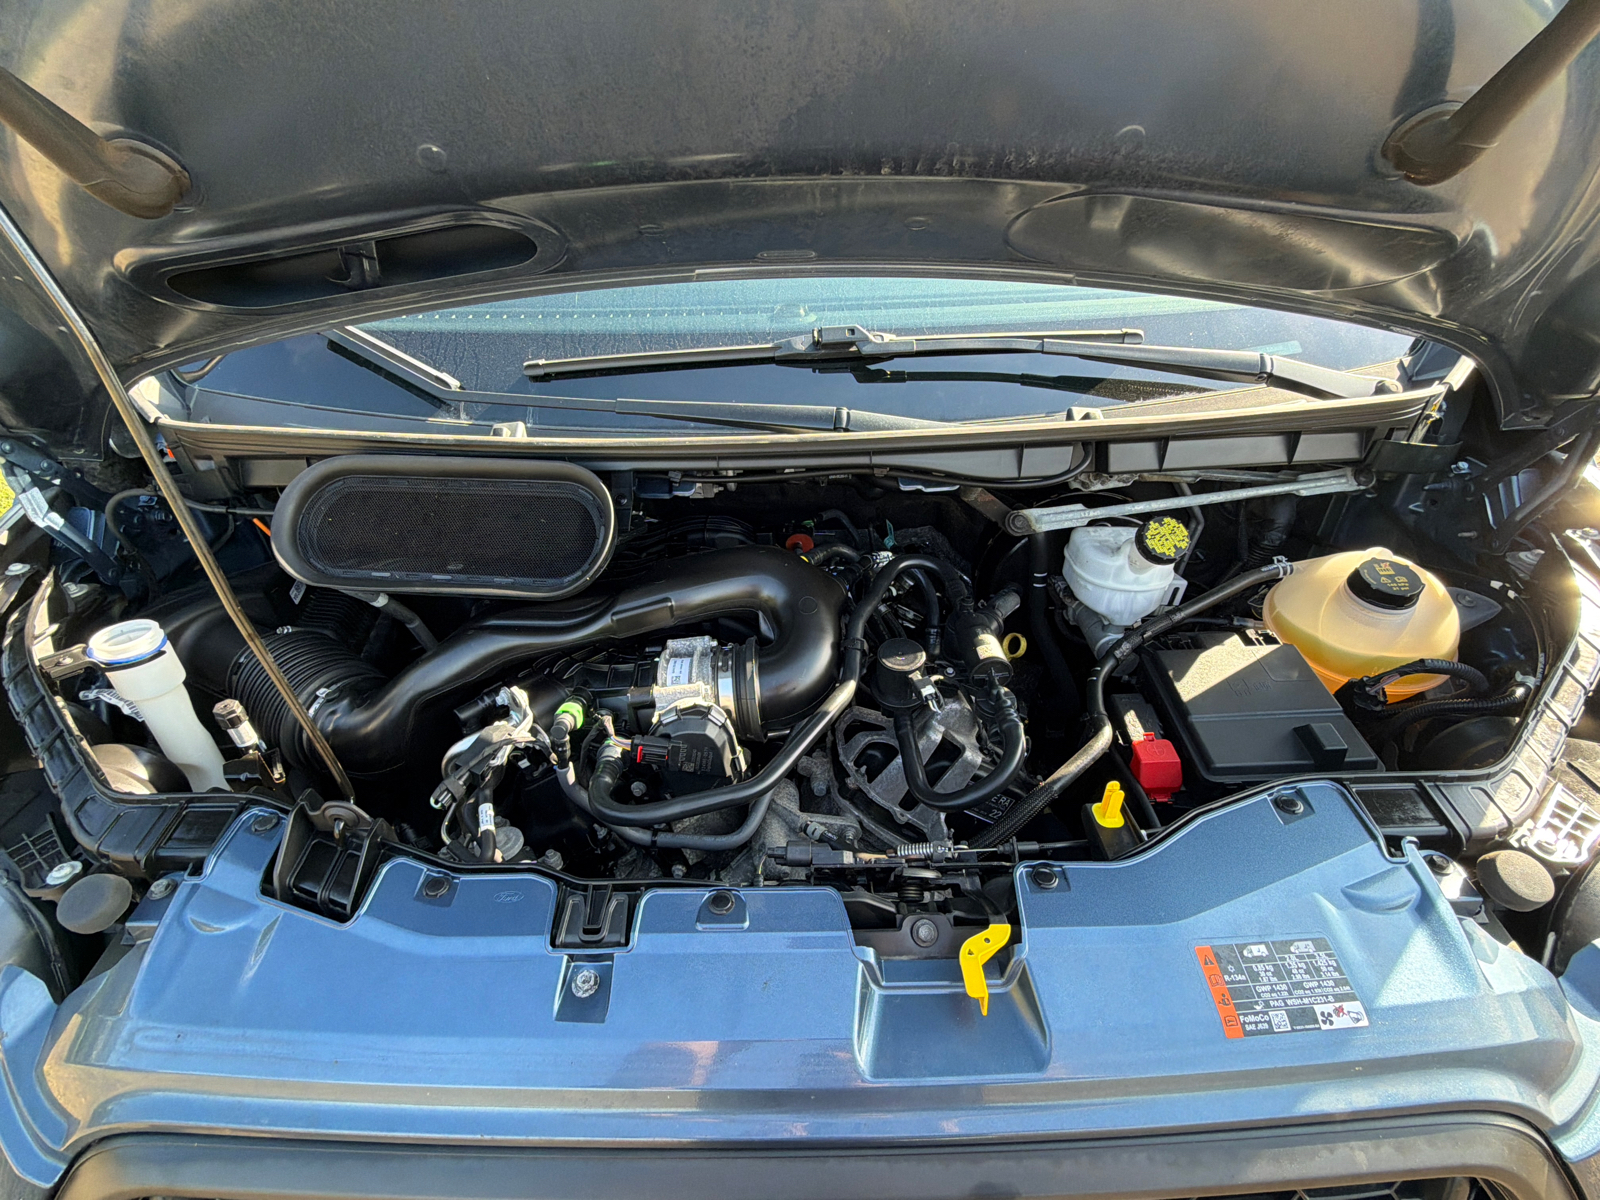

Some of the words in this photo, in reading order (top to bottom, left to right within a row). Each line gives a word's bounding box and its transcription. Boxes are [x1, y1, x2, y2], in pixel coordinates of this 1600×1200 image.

[1272, 983, 1288, 991] 1430
[1269, 999, 1284, 1007] PAG
[1240, 1014, 1269, 1023] FoMoCo
[1244, 1023, 1256, 1031] SAE
